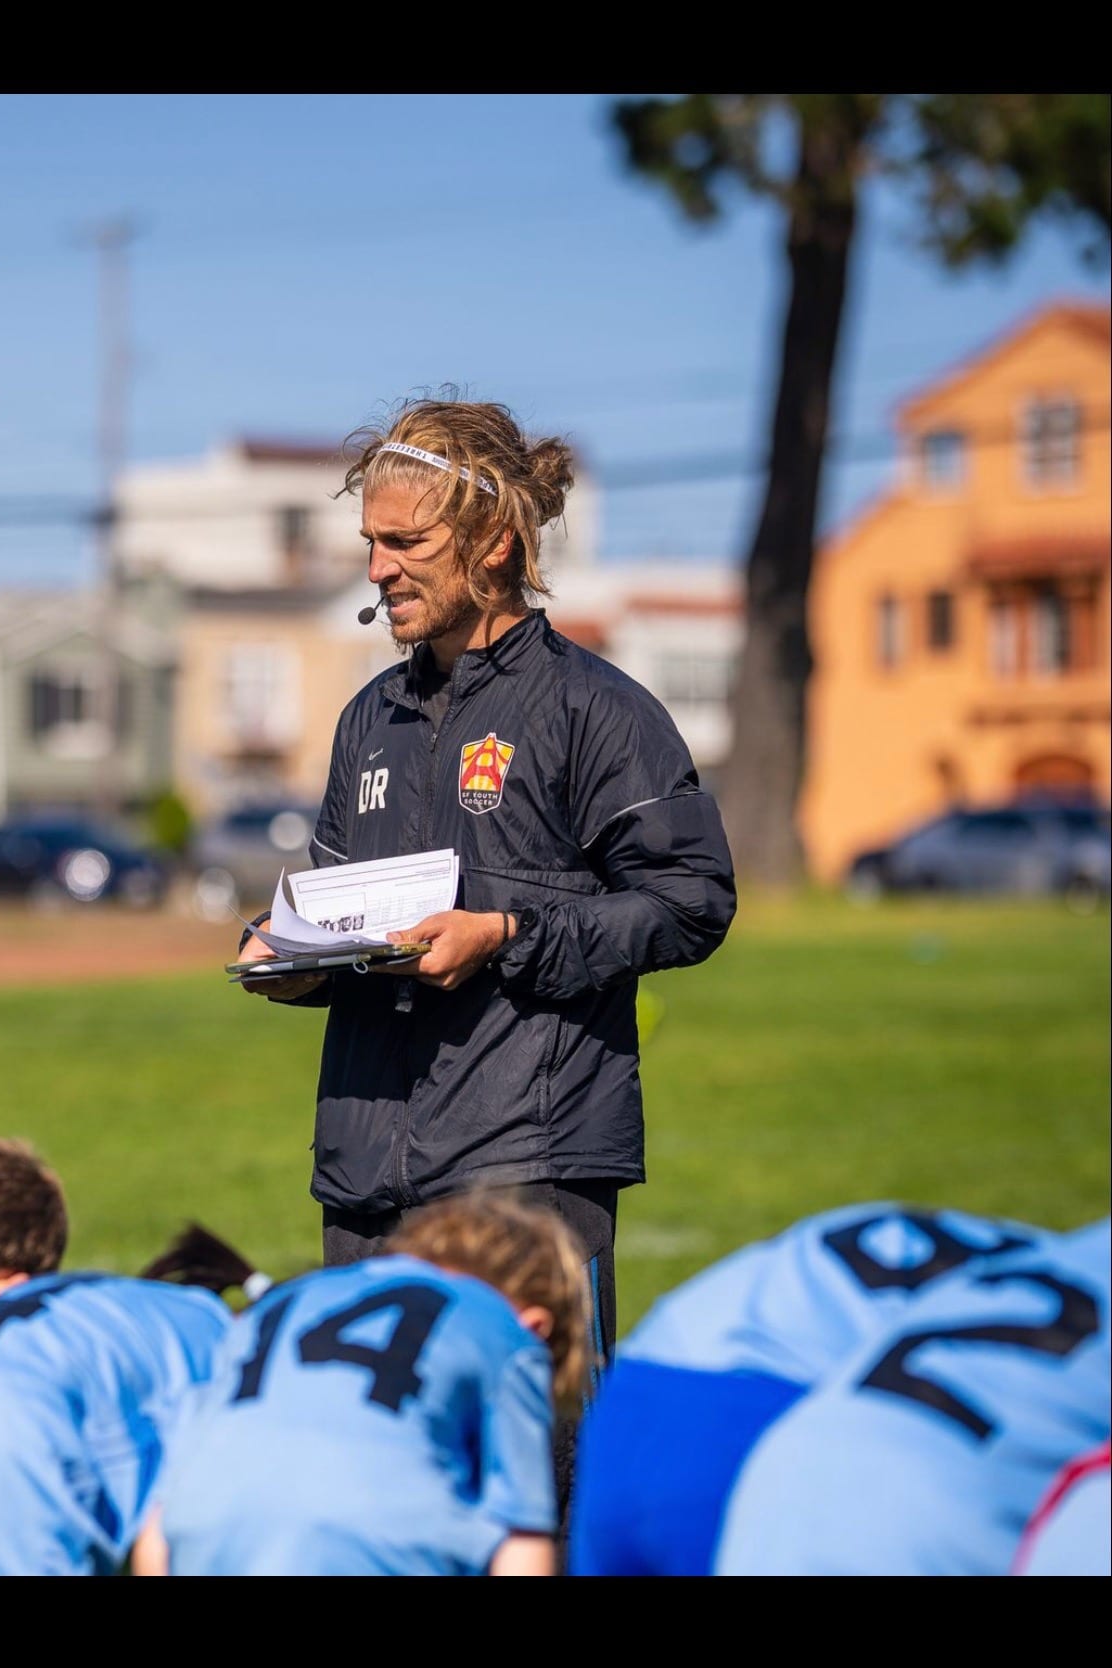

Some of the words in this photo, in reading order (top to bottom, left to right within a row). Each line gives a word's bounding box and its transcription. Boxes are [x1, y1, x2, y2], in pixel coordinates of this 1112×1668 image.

[358, 768, 388, 814] DR
[464, 798, 493, 806] SOCCER
[473, 792, 497, 800] YOUTH
[858, 1268, 1101, 1440] 2
